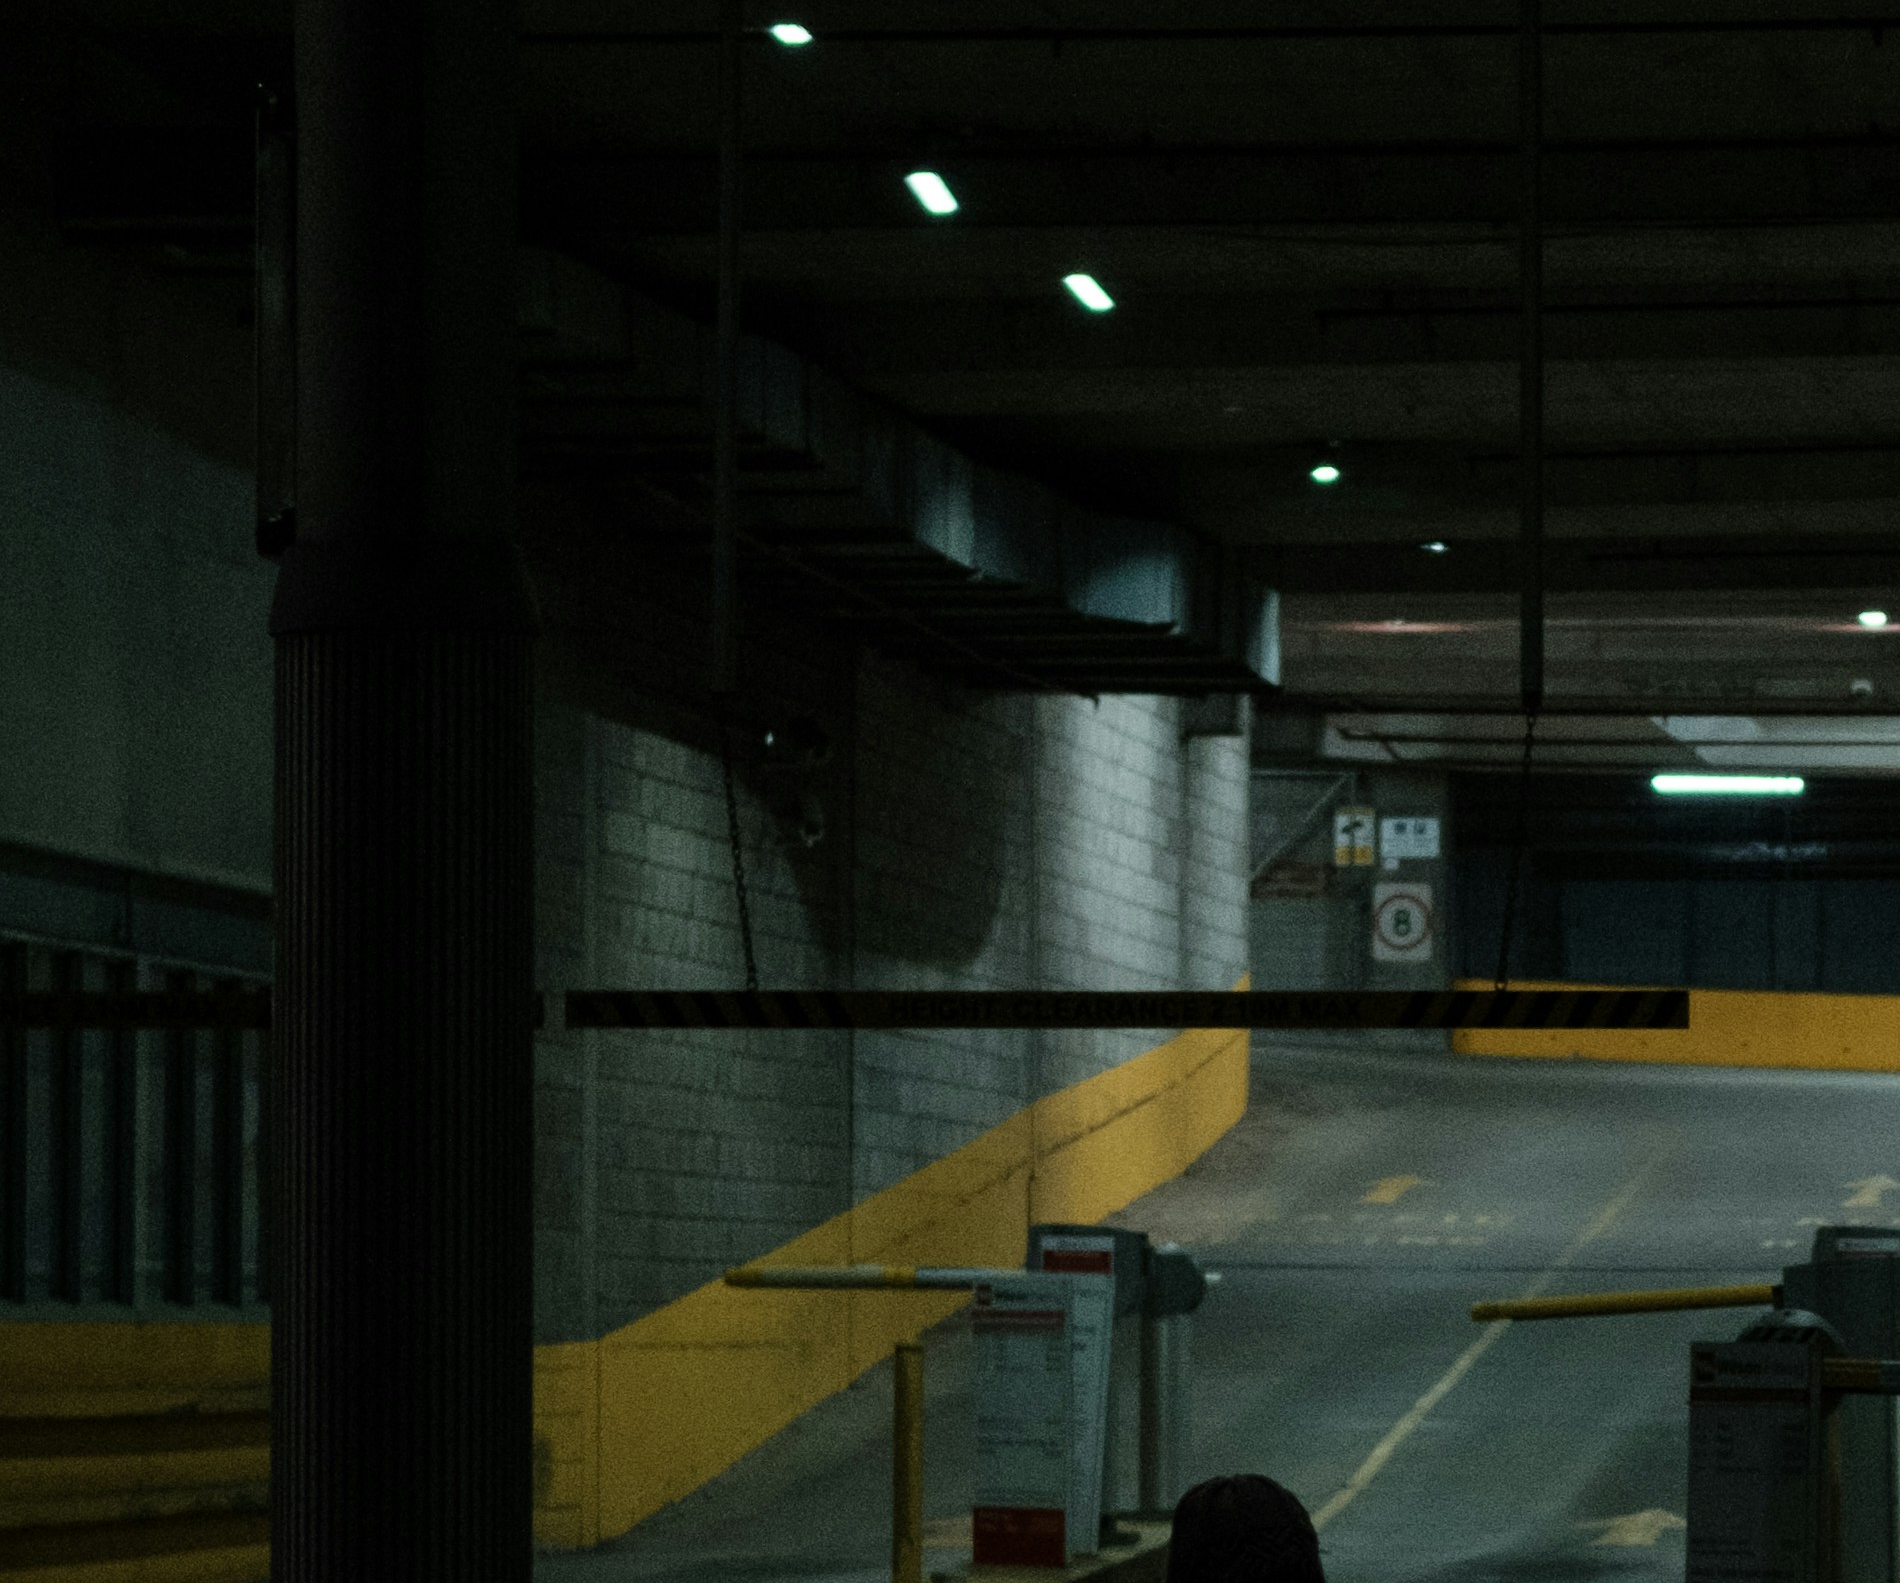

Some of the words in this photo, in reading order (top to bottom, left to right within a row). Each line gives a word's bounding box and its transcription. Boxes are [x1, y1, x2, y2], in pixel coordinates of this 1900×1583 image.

[1393, 910, 1411, 936] 8
[159, 997, 219, 1020] MAX
[890, 999, 999, 1019] HEIGHT
[1013, 999, 1199, 1020] CLEARANCE
[1300, 999, 1361, 1020] MAX
